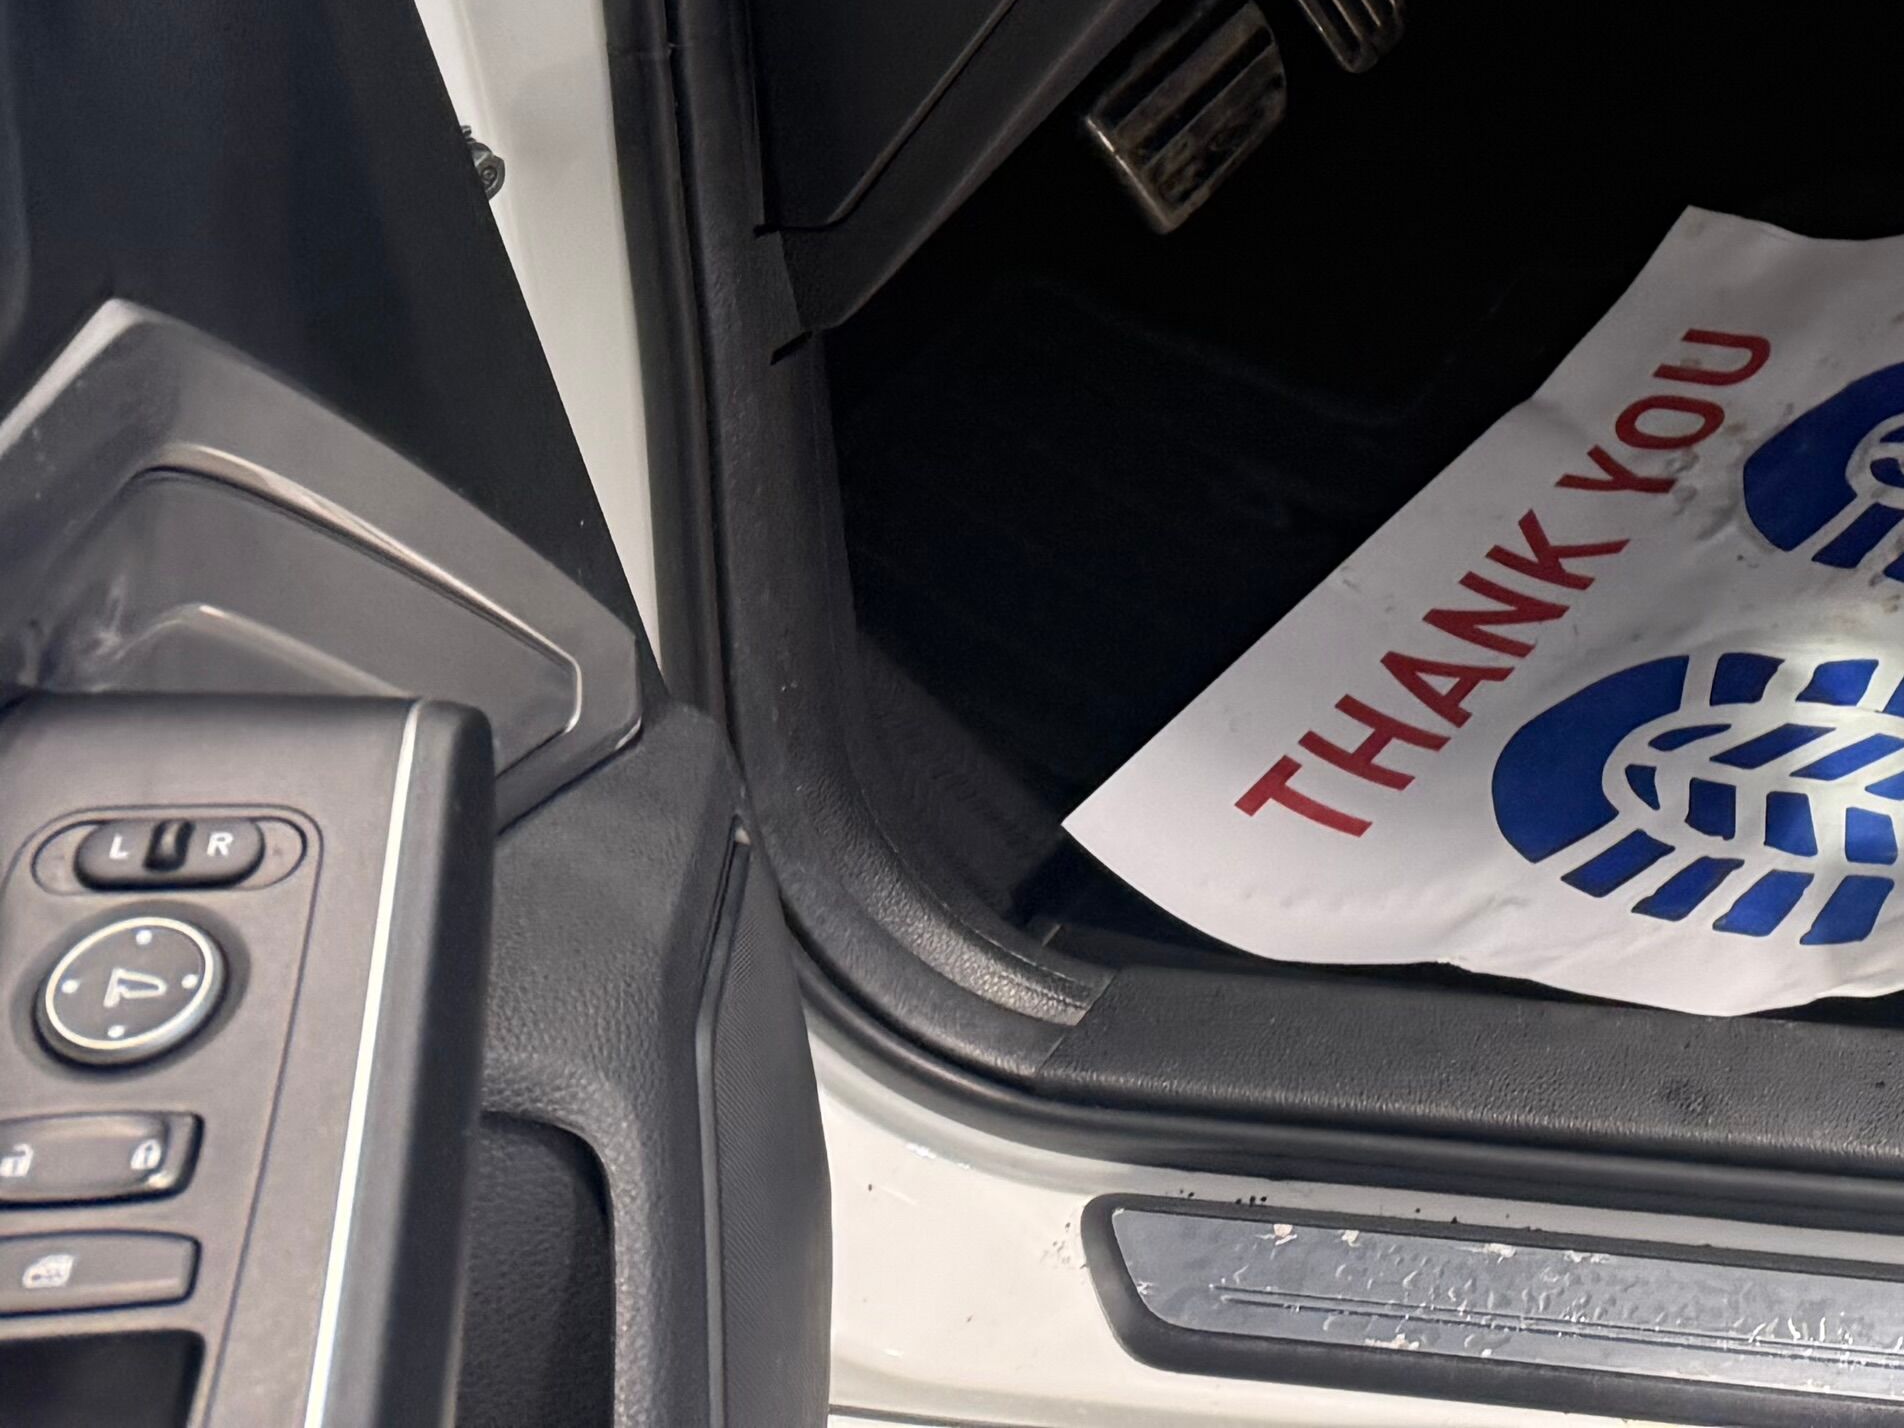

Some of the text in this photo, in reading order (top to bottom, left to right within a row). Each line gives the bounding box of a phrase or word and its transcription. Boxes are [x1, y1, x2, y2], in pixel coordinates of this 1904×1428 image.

[1234, 328, 1771, 837] THANK YOU
[108, 833, 129, 860] L
[206, 831, 233, 857] R
